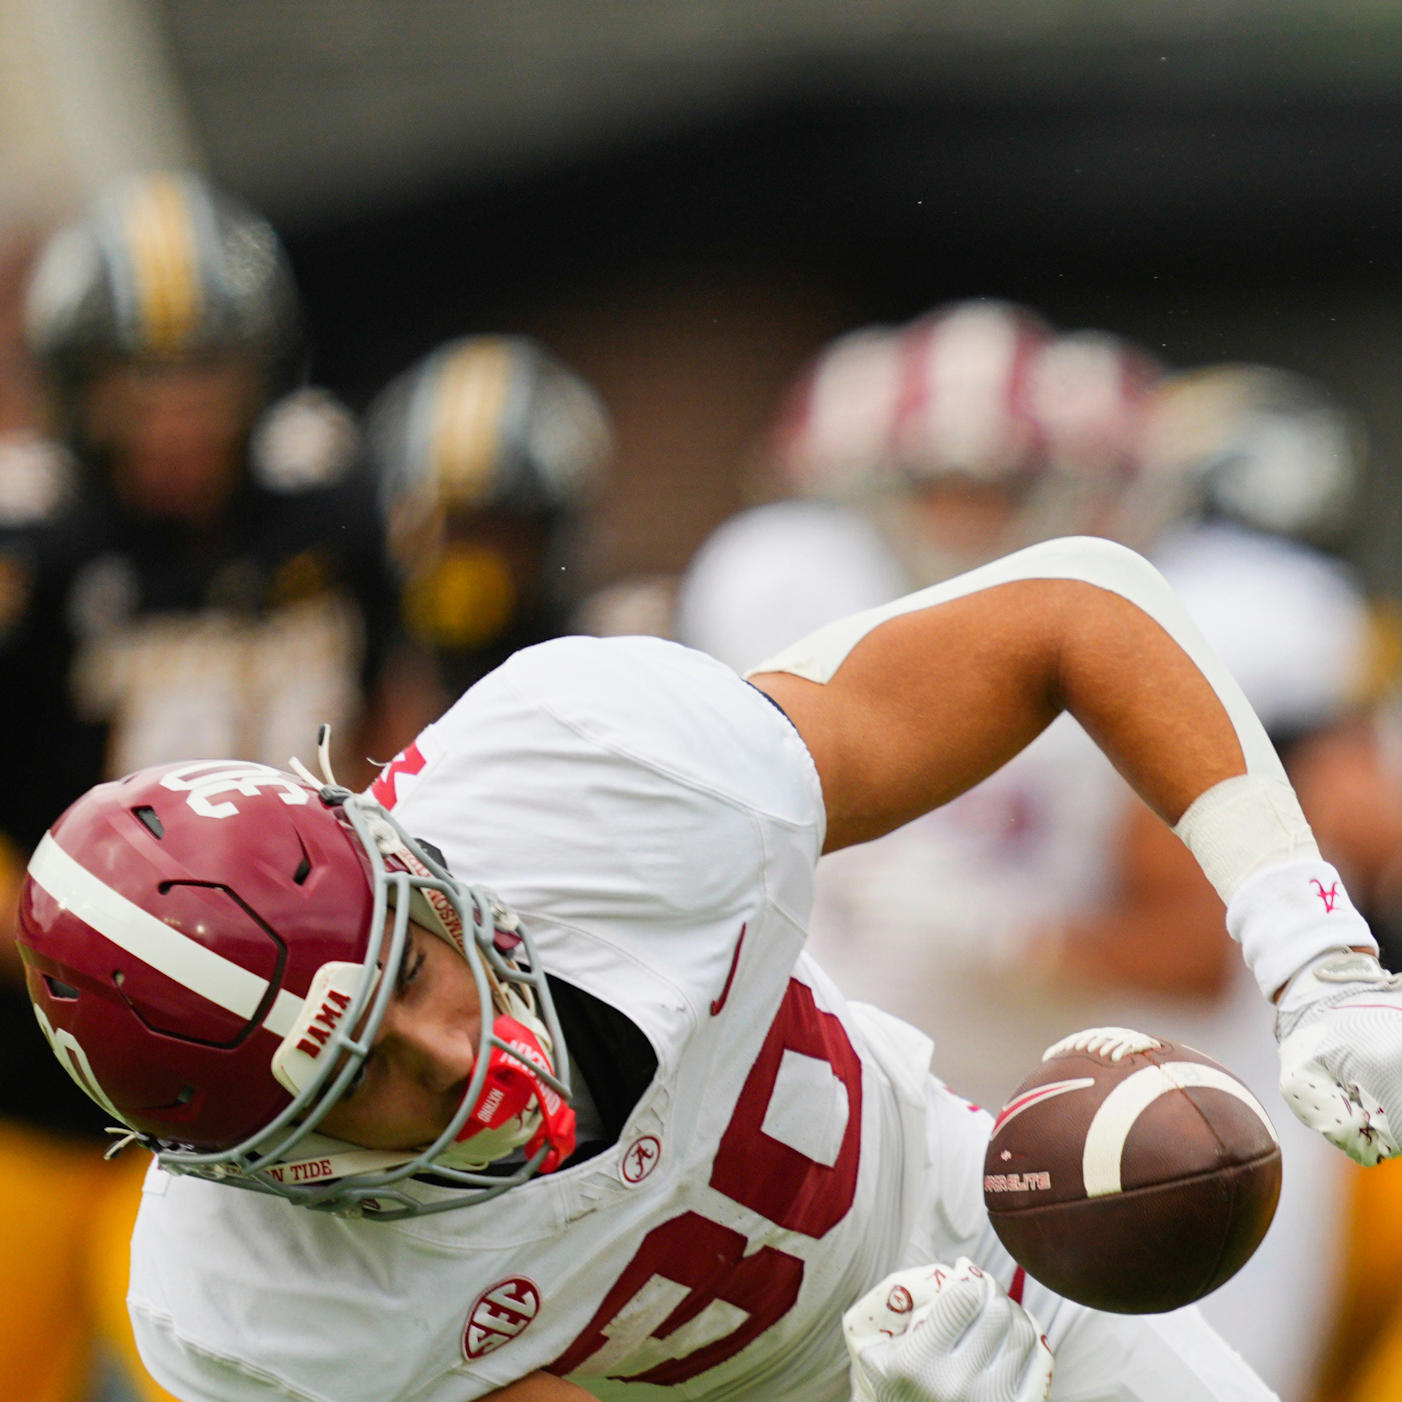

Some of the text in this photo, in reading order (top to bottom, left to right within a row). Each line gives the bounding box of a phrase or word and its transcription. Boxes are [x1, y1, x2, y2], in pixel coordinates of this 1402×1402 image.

[295, 989, 351, 1059] BAMA
[290, 1159, 332, 1182] TIDE
[467, 1281, 538, 1356] SEC
